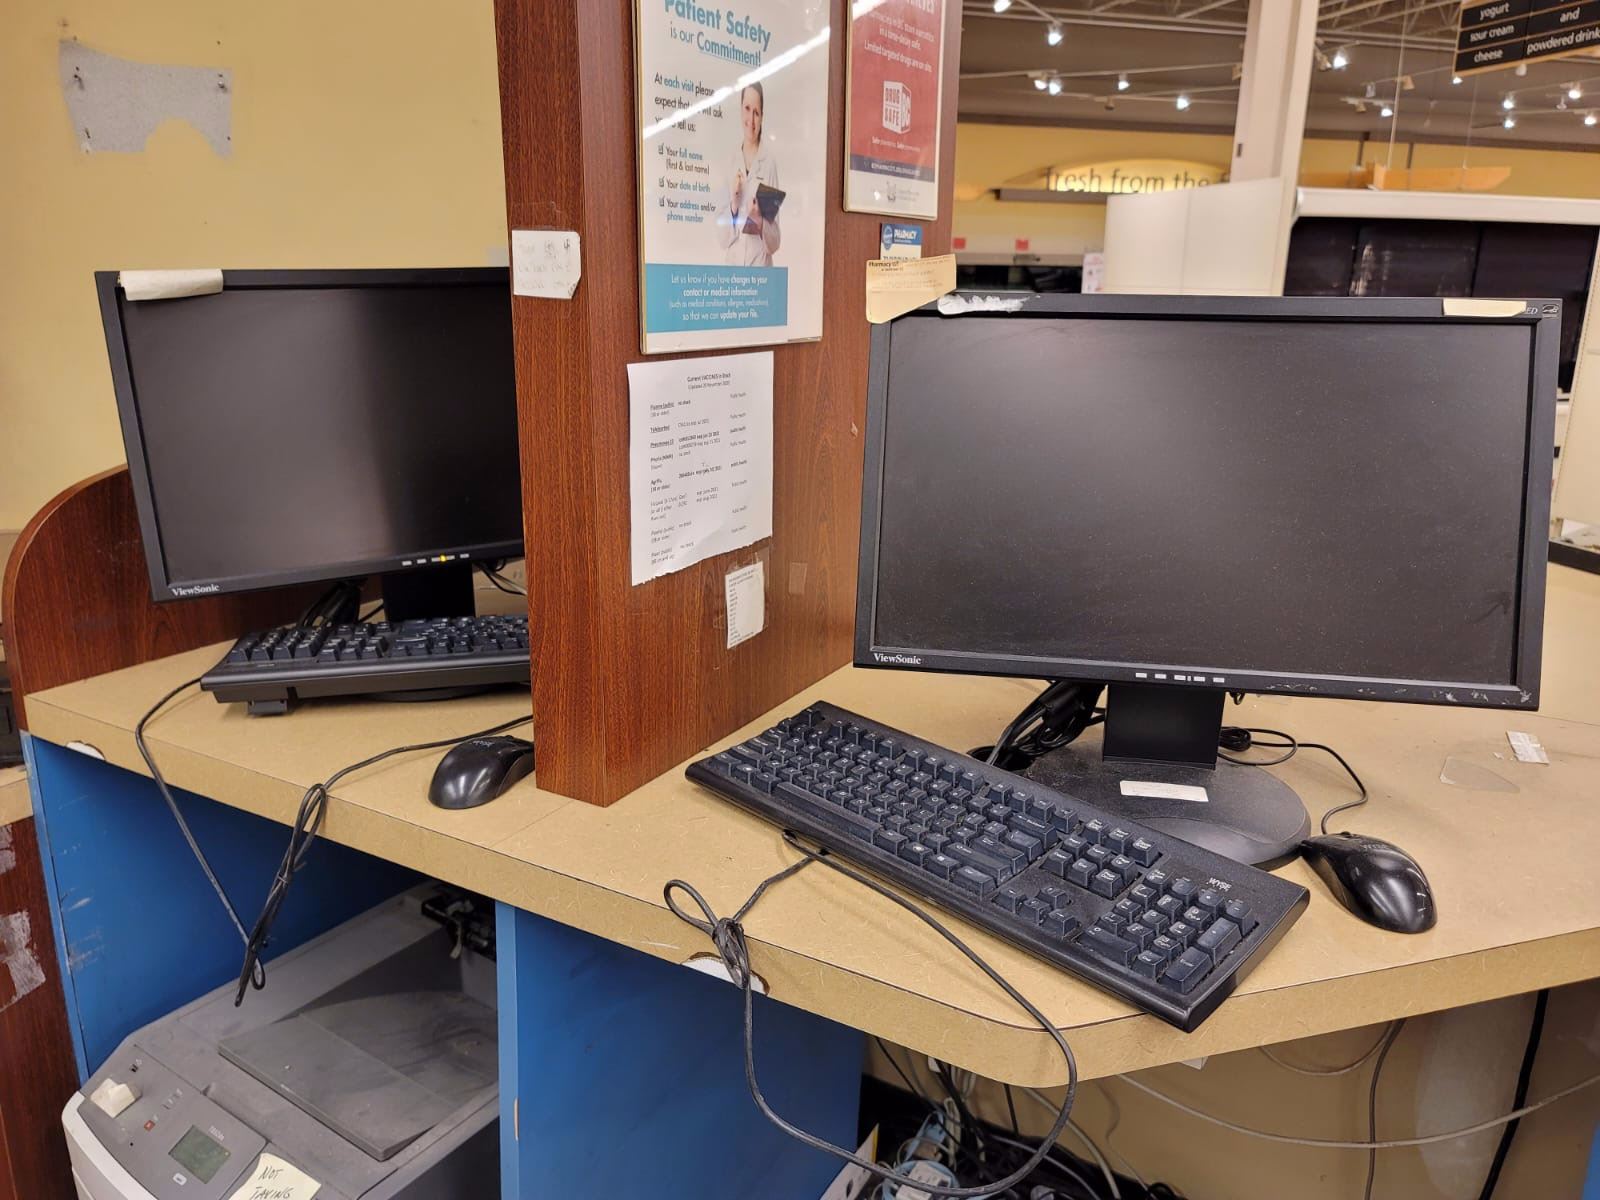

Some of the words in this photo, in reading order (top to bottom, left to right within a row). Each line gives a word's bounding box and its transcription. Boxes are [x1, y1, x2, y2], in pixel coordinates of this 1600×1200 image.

[1479, 3, 1510, 20] yogurt
[1560, 7, 1580, 23] and
[665, 0, 721, 30] Patient
[726, 10, 771, 52] Safety
[1470, 28, 1488, 43] sour
[1488, 24, 1514, 39] cream
[670, 21, 678, 39] is
[679, 30, 694, 44] our
[696, 31, 761, 67] Commitment!
[864, 40, 882, 56] Limited
[1527, 32, 1575, 56] powdered
[1474, 49, 1503, 63] cheese
[654, 72, 663, 85] At
[664, 75, 680, 89] each
[682, 79, 694, 92] visit
[884, 87, 901, 105] DRUG
[654, 96, 676, 110] expect
[713, 105, 723, 119] ask
[884, 107, 901, 127] SAFE
[666, 145, 678, 157] Your
[679, 147, 688, 158] full
[688, 152, 703, 161] name
[666, 159, 678, 171] (first
[678, 160, 684, 171] &
[684, 161, 694, 172] last
[694, 164, 709, 176] name)
[666, 179, 678, 189] Your
[679, 180, 691, 191] date
[692, 181, 698, 191] of
[698, 182, 711, 193] birth
[1044, 166, 1101, 192] fresh
[1111, 168, 1164, 193] from
[1173, 171, 1209, 189] the
[666, 198, 678, 209] Your
[680, 199, 700, 211] address
[700, 201, 716, 213] and/or
[667, 209, 684, 223] phone
[684, 212, 704, 223] number
[671, 273, 681, 283] Let
[687, 273, 701, 283] know
[707, 275, 717, 286] you
[717, 273, 730, 284] have
[730, 273, 751, 286] changes
[751, 275, 757, 284] to
[757, 276, 768, 286] your
[683, 286, 703, 297] contact
[703, 289, 710, 297] or
[710, 286, 731, 297] medical
[731, 286, 758, 297] information
[682, 312, 690, 321] so
[690, 310, 700, 321] that
[701, 311, 709, 320] we
[709, 311, 719, 320] can
[719, 309, 738, 322] update
[738, 311, 750, 321] your
[749, 308, 760, 319] file.
[171, 583, 220, 597] ViewSonic
[873, 652, 922, 665] ViewSonic
[258, 1165, 284, 1181] NOT
